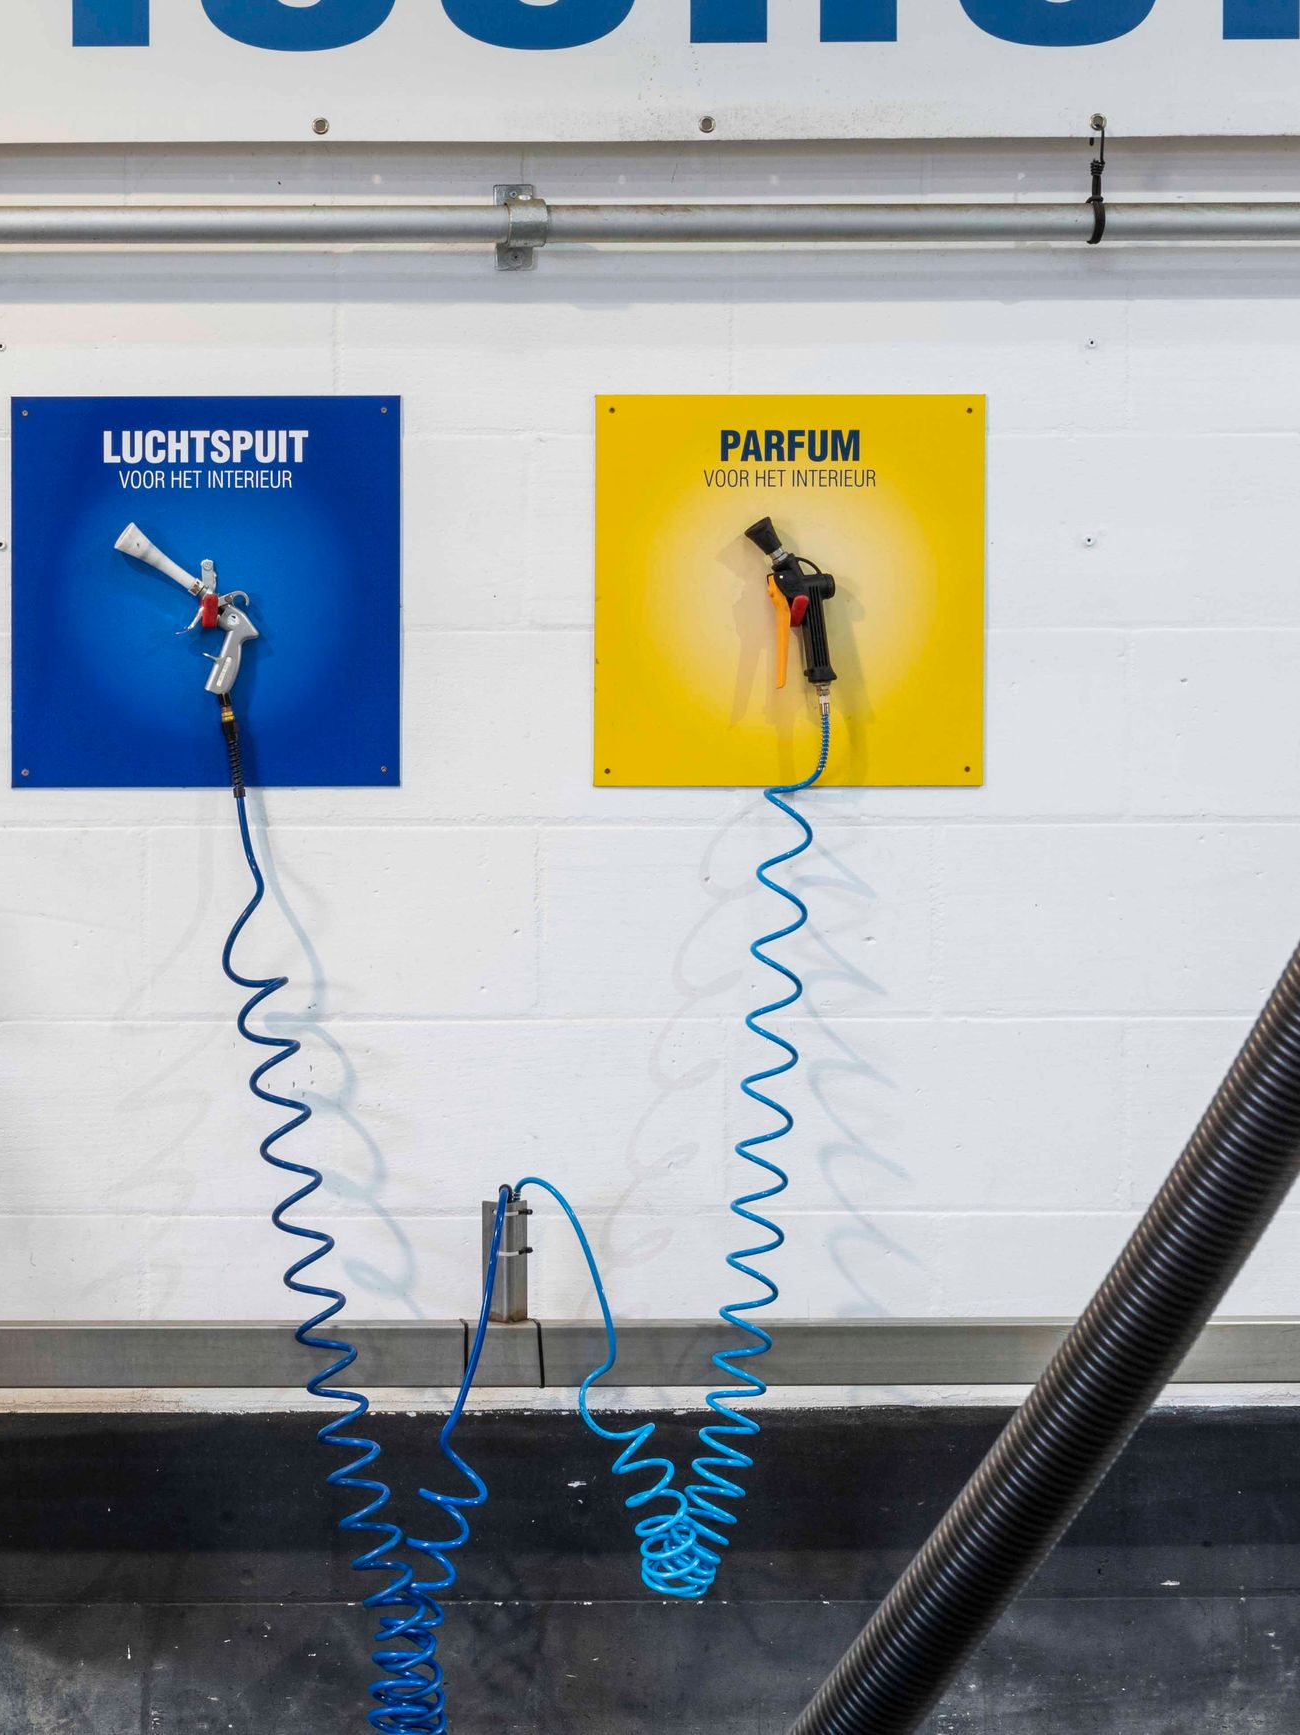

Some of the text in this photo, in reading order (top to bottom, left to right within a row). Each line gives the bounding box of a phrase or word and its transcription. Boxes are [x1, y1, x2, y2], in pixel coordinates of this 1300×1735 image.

[103, 430, 309, 464] LUCHTSPUIT
[720, 429, 860, 462] PARFUM
[118, 470, 292, 489] VOOR HET INTERIEUR
[703, 469, 876, 488] VOOR HET INTERIEUR
